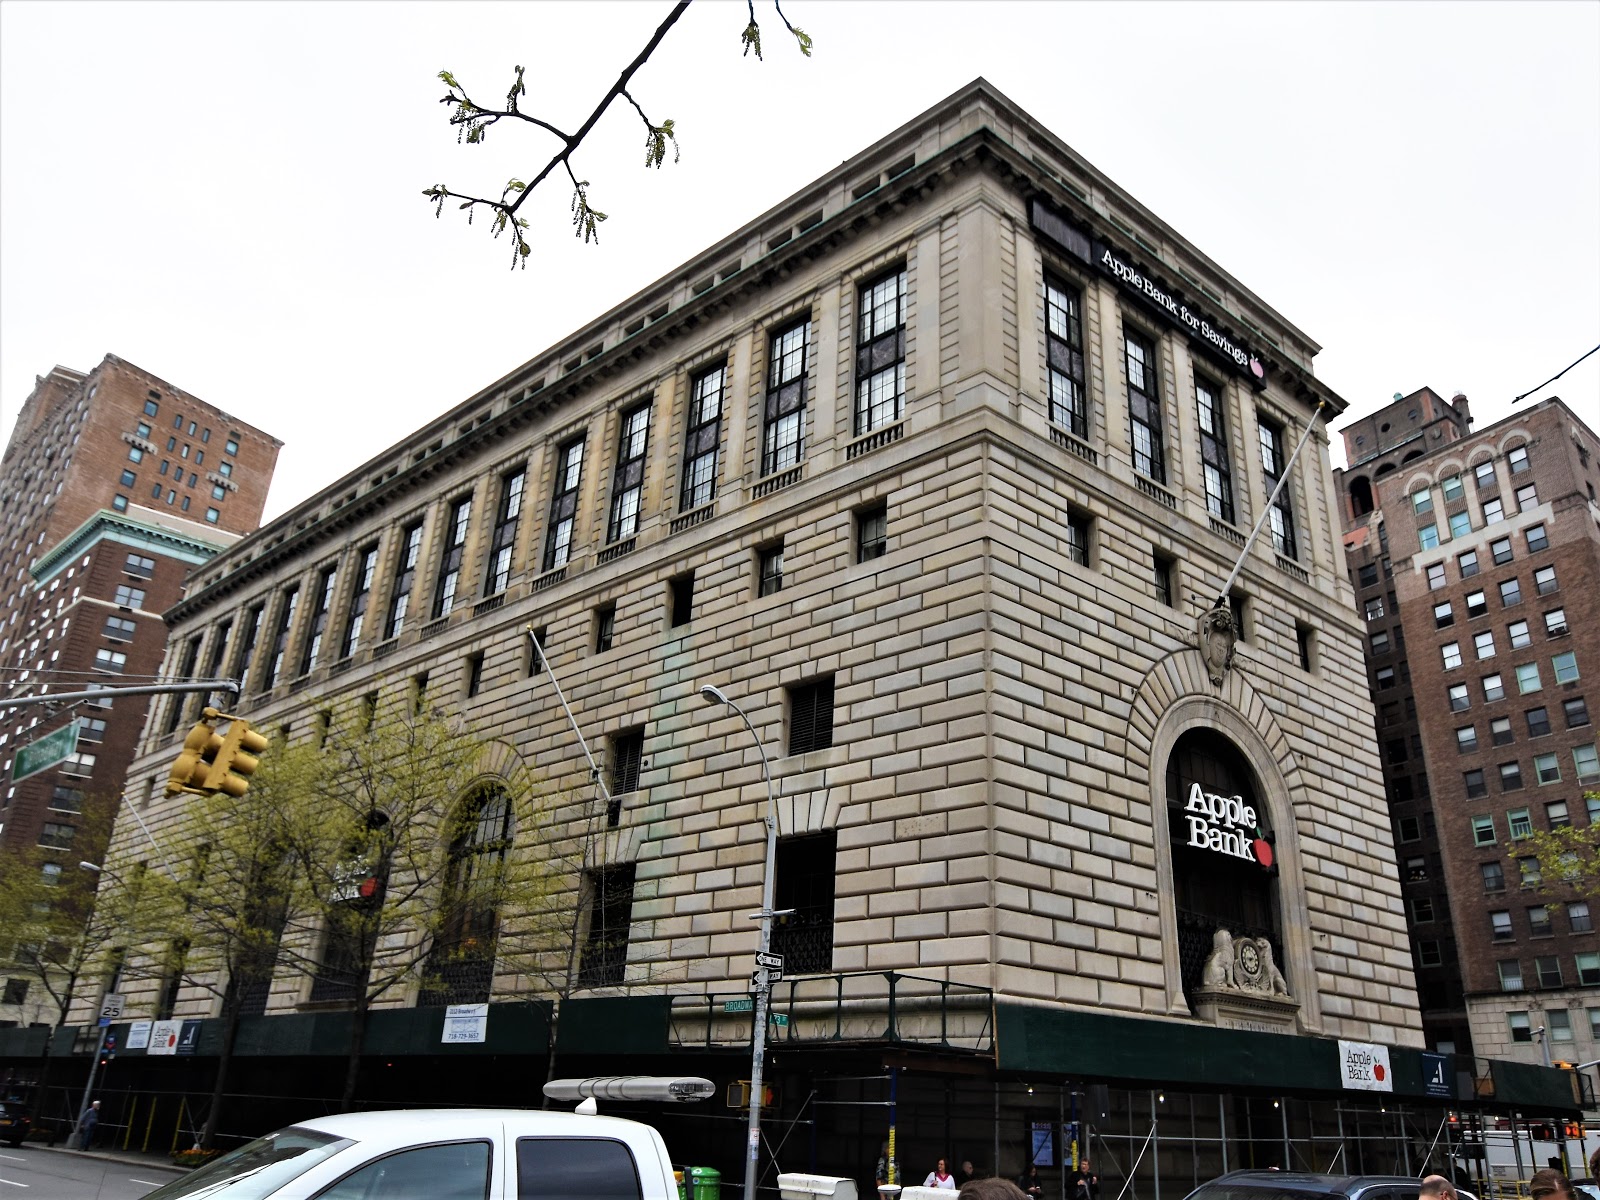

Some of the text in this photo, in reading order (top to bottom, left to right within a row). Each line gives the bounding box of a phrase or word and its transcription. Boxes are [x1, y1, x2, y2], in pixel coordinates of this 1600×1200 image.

[1102, 250, 1248, 366] Apple Bank for Savings
[1184, 782, 1257, 829] Apple
[1184, 815, 1257, 862] Bank
[102, 1006, 120, 1017] 25
[726, 1001, 752, 1011] BROADWA
[1346, 1049, 1372, 1067] Apple
[1347, 1064, 1372, 1081] Bank
